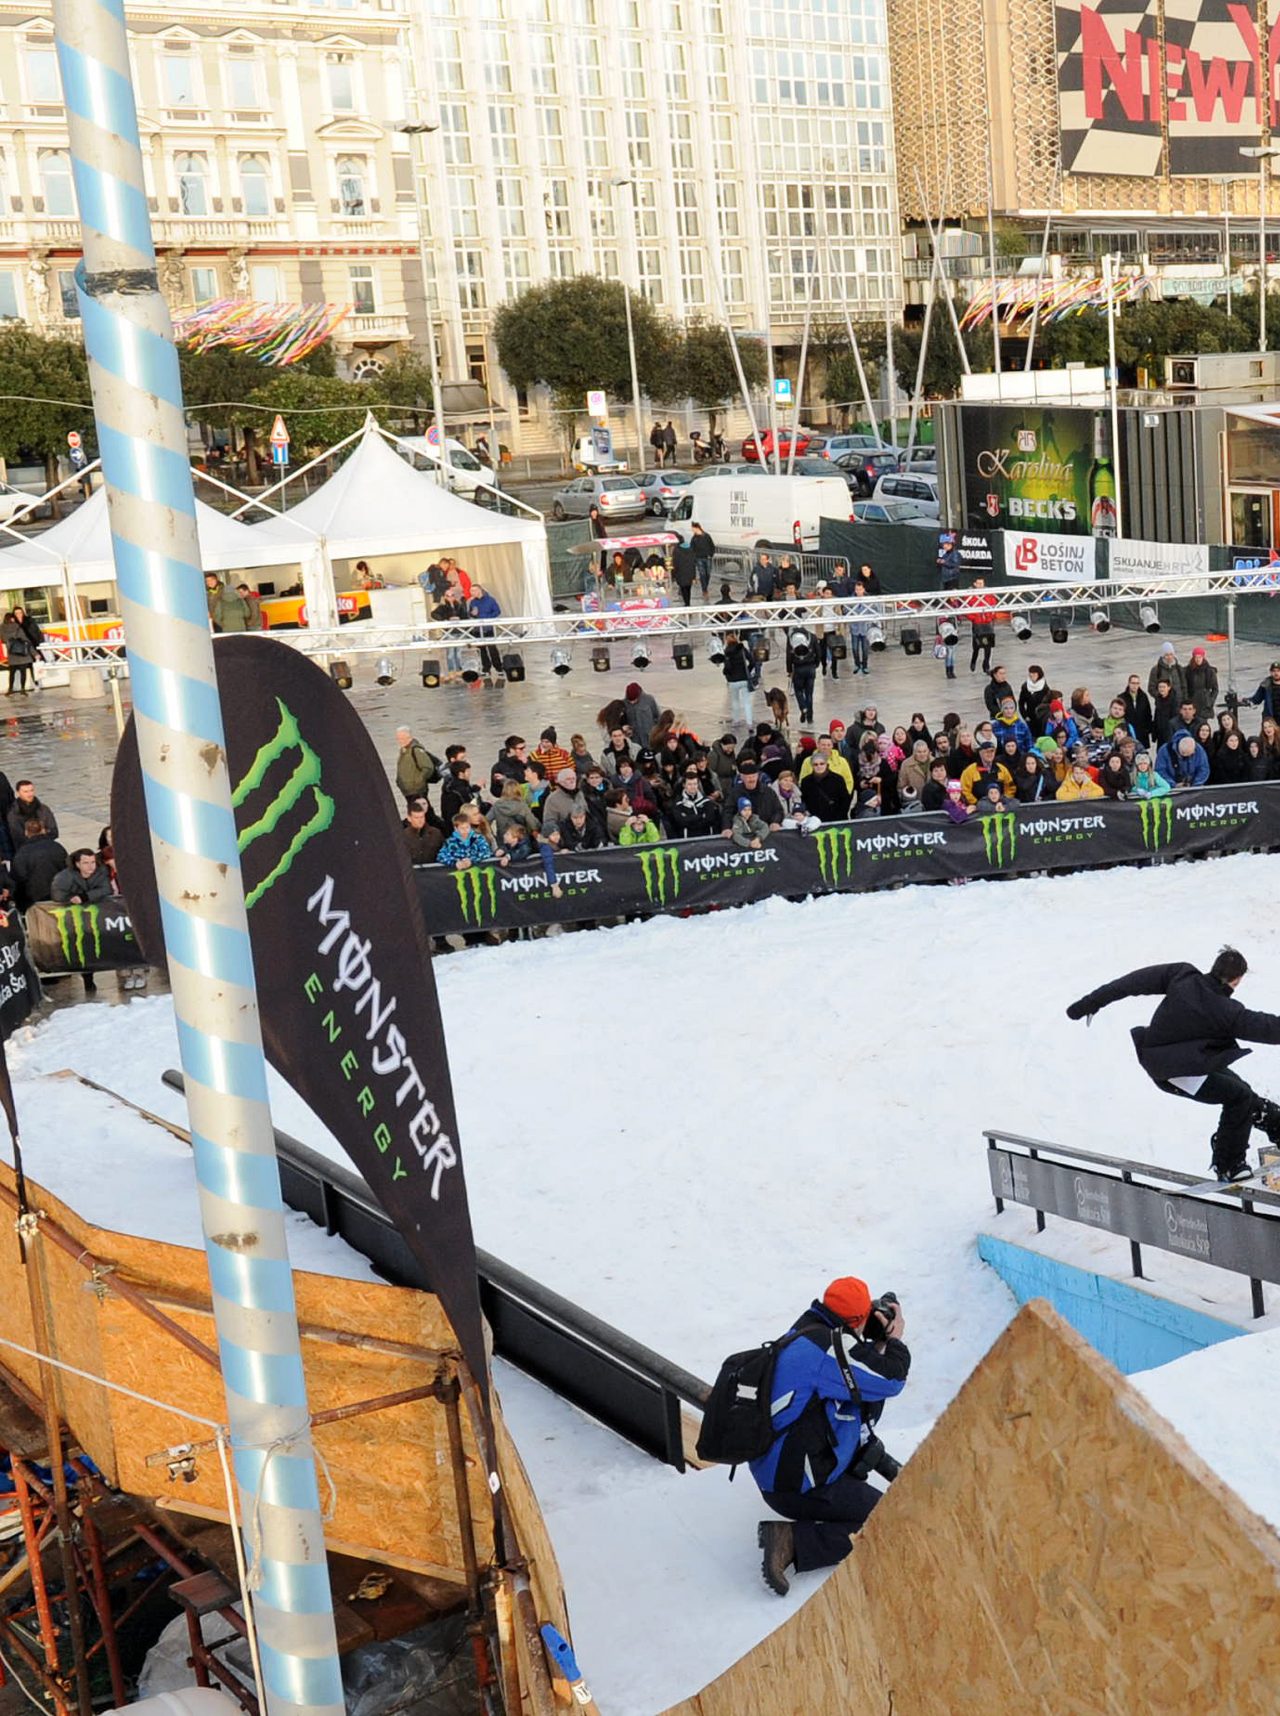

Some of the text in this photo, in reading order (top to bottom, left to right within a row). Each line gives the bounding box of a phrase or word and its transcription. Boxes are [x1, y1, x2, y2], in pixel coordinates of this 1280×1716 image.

[977, 449, 1074, 480] Karolina
[1008, 498, 1077, 520] BECK'S
[962, 535, 988, 547] ŠKOLA
[1041, 542, 1084, 560] LOŠINJ
[1041, 559, 1084, 573] BETON
[1176, 801, 1259, 820] MONSTER
[1020, 815, 1106, 835] MONSTER
[1189, 818, 1247, 828] ENERGY
[857, 831, 947, 852] MONSTER
[1034, 832, 1094, 844] ENERGY
[684, 848, 779, 872] MONSTER
[871, 848, 934, 860] ENERGY
[700, 866, 766, 880] ENERGY
[518, 887, 588, 901] ENEGY
[307, 873, 456, 1201] MONSTER
[304, 972, 407, 1181] ENERGY
